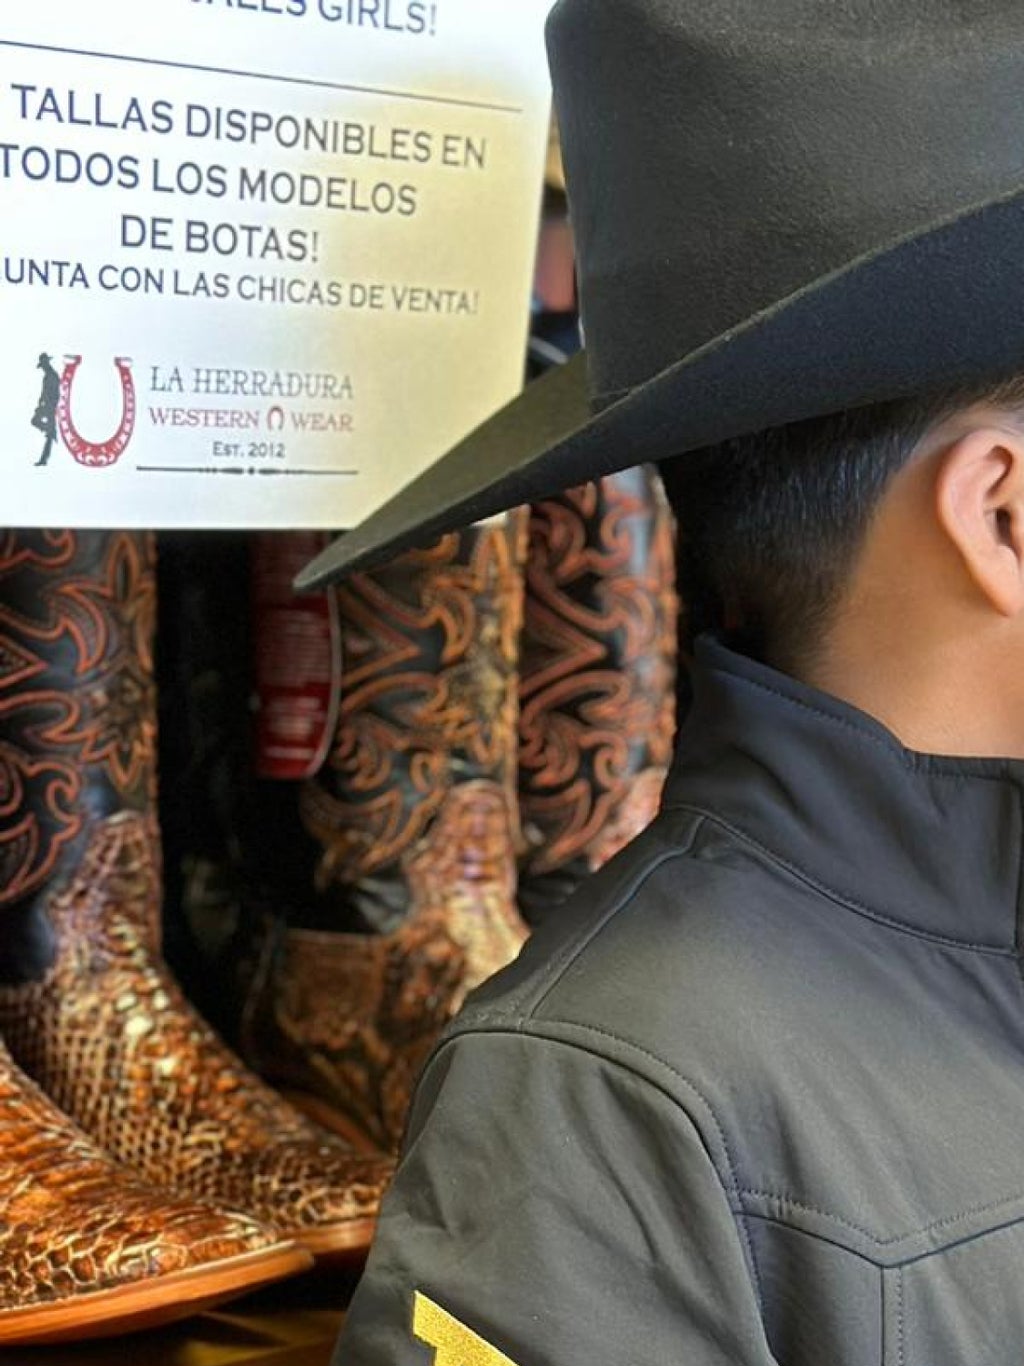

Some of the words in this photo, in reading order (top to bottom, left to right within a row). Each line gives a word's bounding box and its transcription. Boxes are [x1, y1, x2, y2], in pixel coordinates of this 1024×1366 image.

[318, 0, 436, 36] GIRLS!
[11, 83, 173, 134] TALLAS
[186, 103, 432, 163] DISPONIBLES
[442, 134, 486, 169] EN
[0, 143, 140, 189] TODOS
[152, 158, 228, 198] LOS
[239, 167, 418, 216] MODELOS
[121, 214, 174, 251] DE
[186, 220, 320, 262] BOTAS!
[98, 264, 164, 293] CON
[173, 269, 230, 298] LAS
[237, 275, 342, 306] CHICAS
[350, 283, 384, 309] DE
[391, 286, 480, 314] VENTA!
[150, 366, 184, 393] LA
[193, 368, 354, 399] HERRADURA
[149, 407, 260, 428] WESTERN
[291, 412, 354, 431] WEAR
[248, 442, 286, 458] 2012
